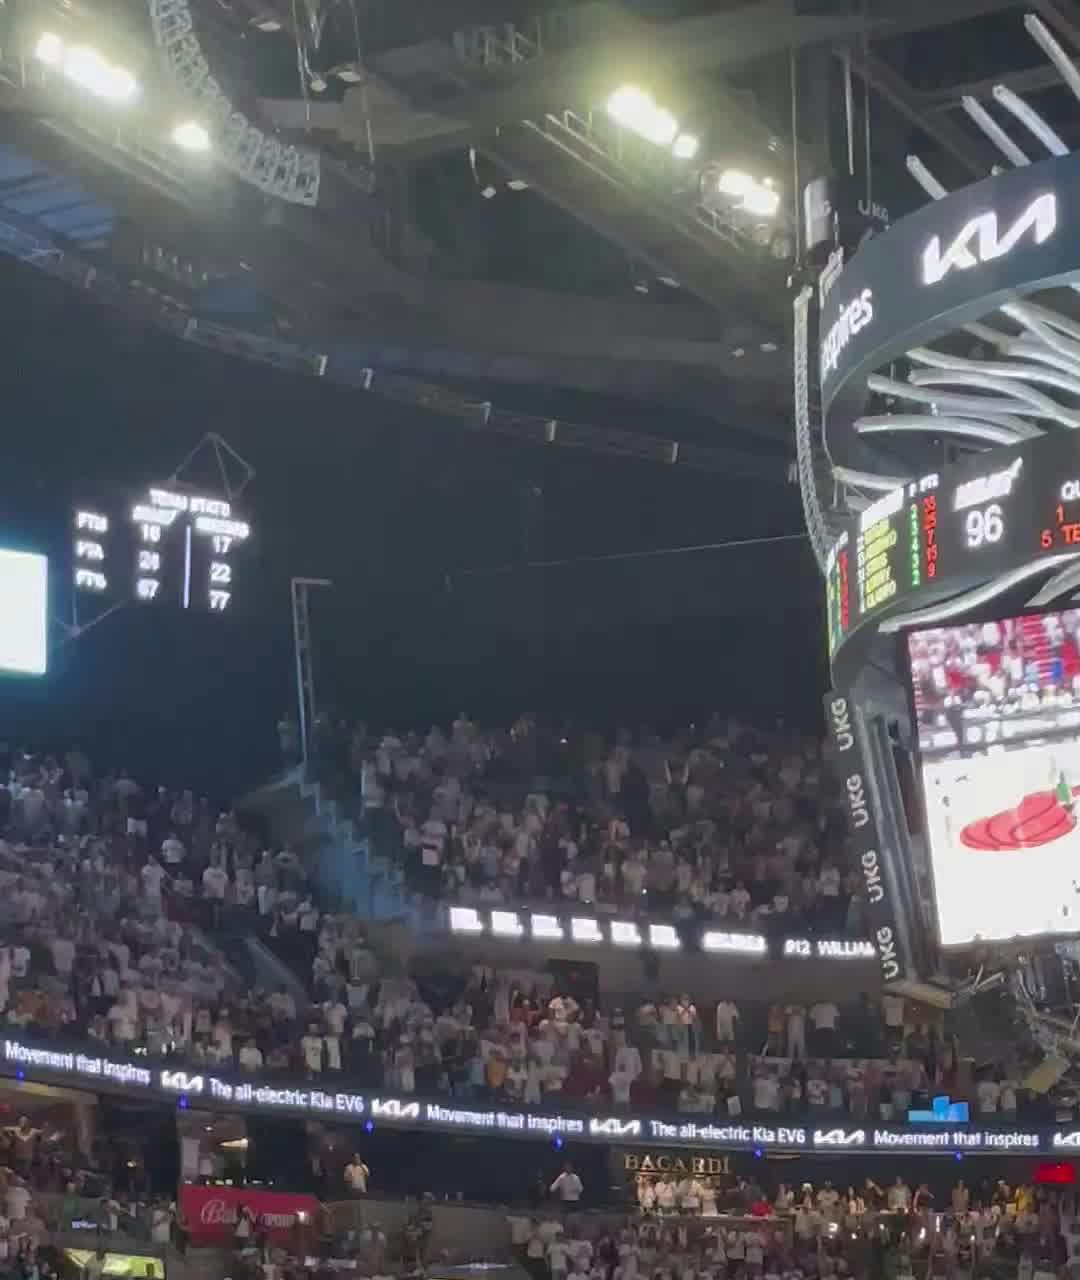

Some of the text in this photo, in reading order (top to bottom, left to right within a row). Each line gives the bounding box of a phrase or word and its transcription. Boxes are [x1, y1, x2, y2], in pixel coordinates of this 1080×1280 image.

[966, 503, 1004, 548] 96
[1056, 507, 1064, 523] 1
[210, 562, 231, 583] 22
[832, 697, 856, 752] UKG
[846, 774, 870, 829] UKG
[861, 849, 884, 904] UKG
[876, 925, 898, 981] UKG
[4, 1040, 73, 1073] Movement
[211, 1077, 233, 1100] The
[235, 1082, 306, 1107] all-electric
[335, 1091, 363, 1114] EV6
[427, 1103, 495, 1127] Movement
[499, 1109, 524, 1129] that
[528, 1113, 583, 1135] inspires
[651, 1120, 676, 1137] The
[679, 1122, 750, 1142] all-electric
[753, 1127, 774, 1143] Kia
[777, 1128, 805, 1144] EV6
[874, 1129, 949, 1146] Movement
[953, 1129, 981, 1146] that
[984, 1129, 1039, 1148] inspires
